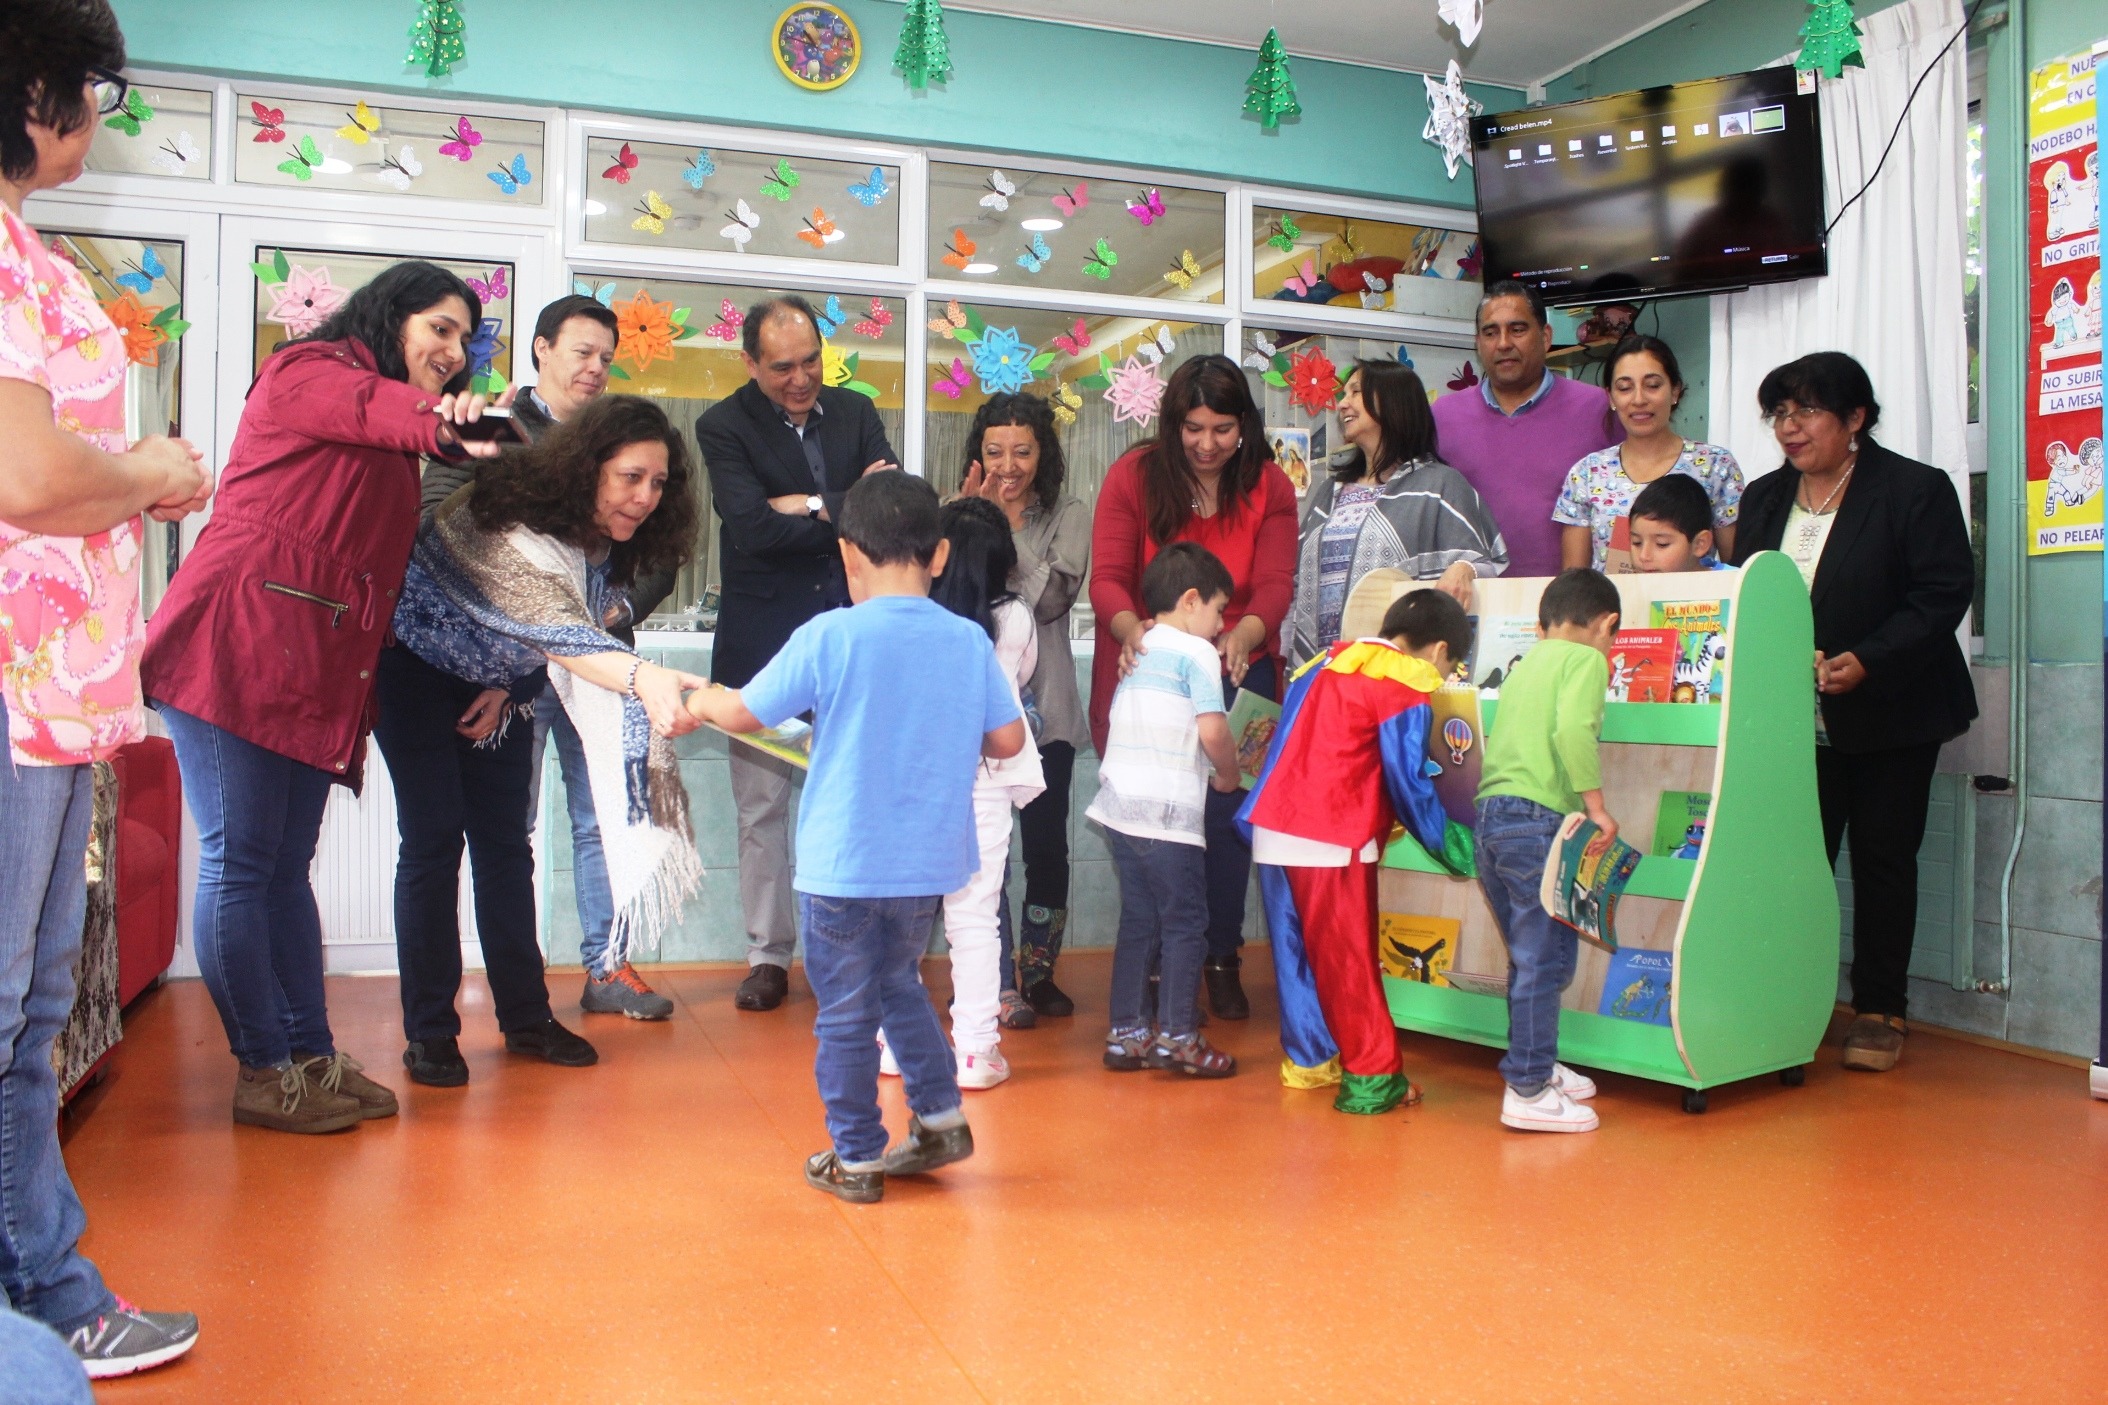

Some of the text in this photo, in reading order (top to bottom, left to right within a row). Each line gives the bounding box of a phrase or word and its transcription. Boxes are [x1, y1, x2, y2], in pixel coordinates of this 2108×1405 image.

[1500, 118, 1553, 133] Cread belen.mp4
[2031, 123, 2098, 154] NODEBO H
[2045, 249, 2063, 263] NO
[2043, 376, 2061, 390] NO
[2050, 391, 2104, 410] LA MESA
[2040, 532, 2058, 545] NO
[1666, 606, 1676, 616] EL
[1680, 604, 1711, 615] MUNDO
[1615, 636, 1663, 645] LOS ANIMALES
[1630, 954, 1662, 967] POPOL
